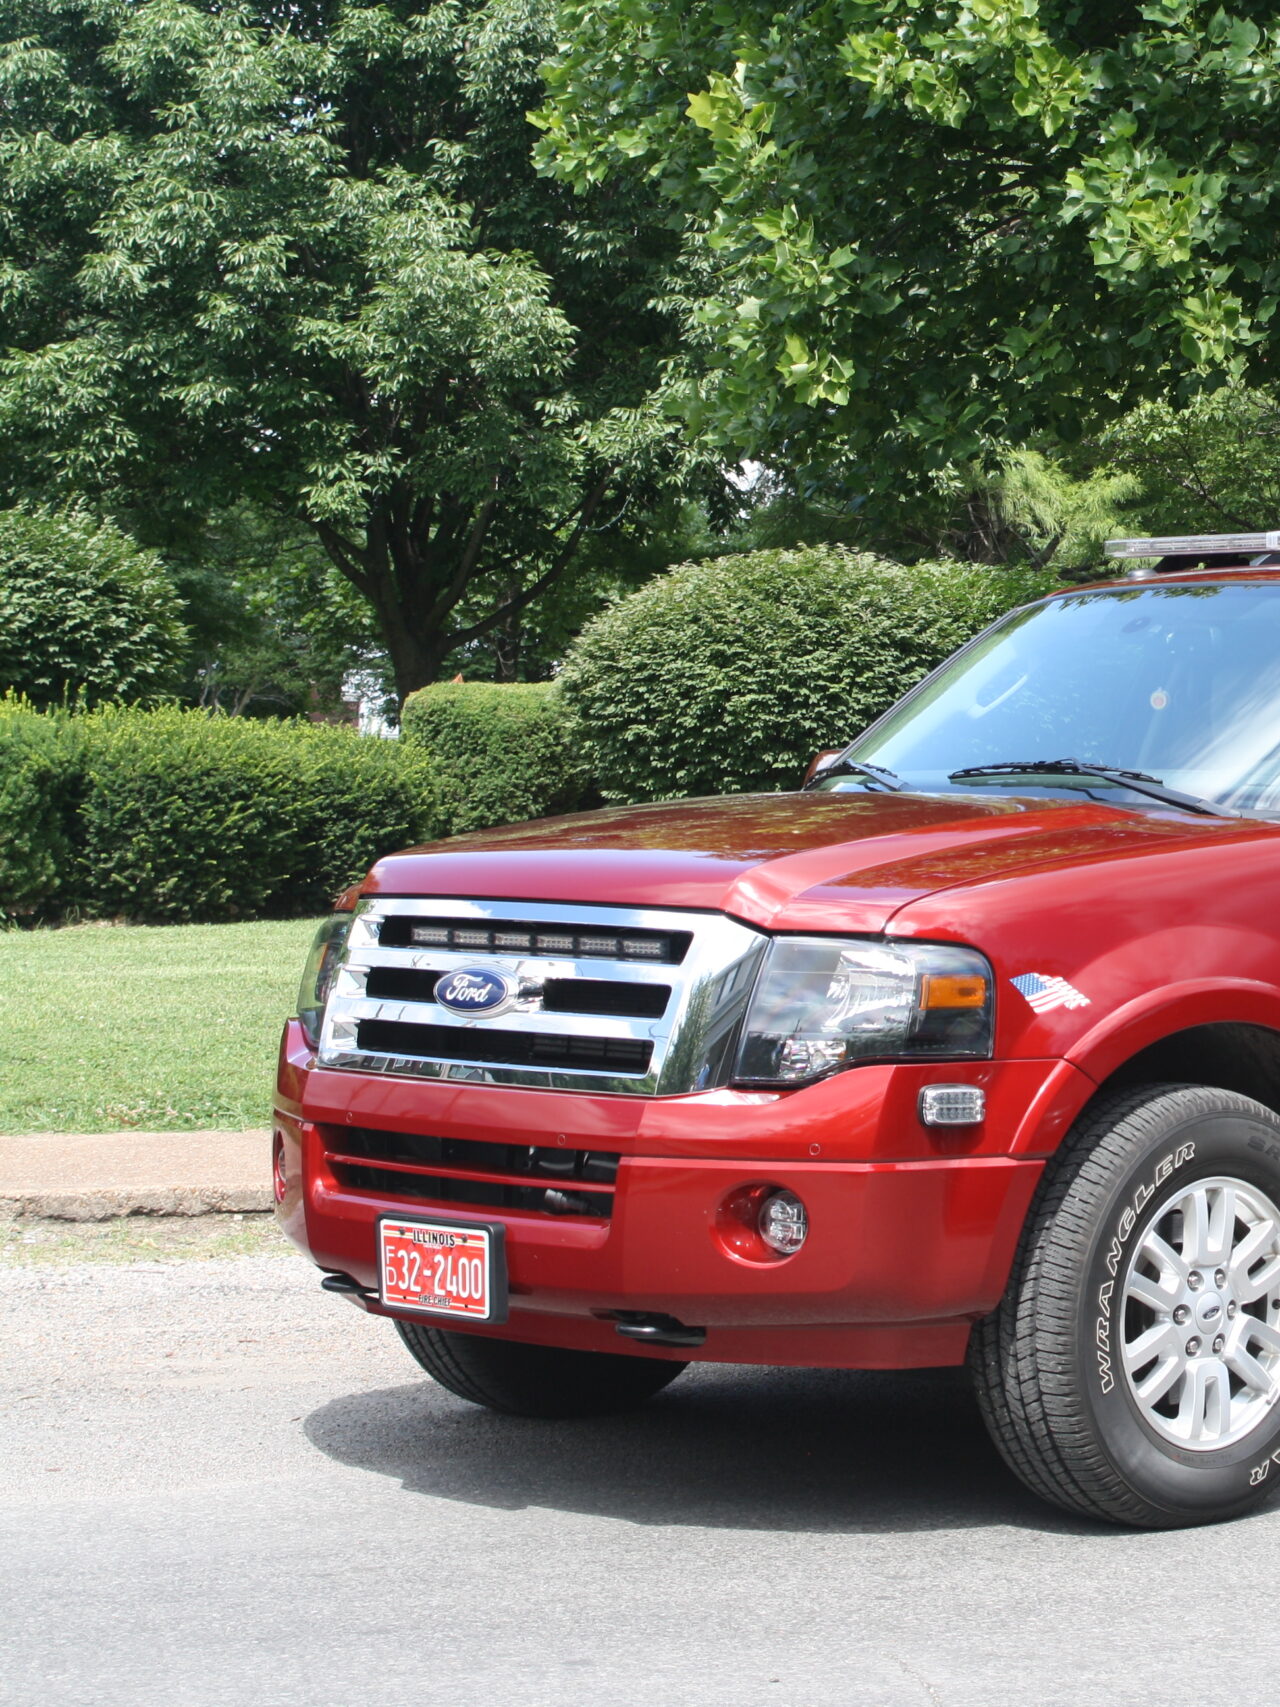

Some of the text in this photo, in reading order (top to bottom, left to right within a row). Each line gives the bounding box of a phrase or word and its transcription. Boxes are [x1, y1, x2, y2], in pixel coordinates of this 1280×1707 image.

[445, 973, 492, 1003] Ford
[412, 1229, 456, 1246] ILLINOIS
[398, 1249, 482, 1299] 32-2400
[1095, 1141, 1195, 1395] WRANGLER
[417, 1294, 452, 1306] FIRE CHIEF
